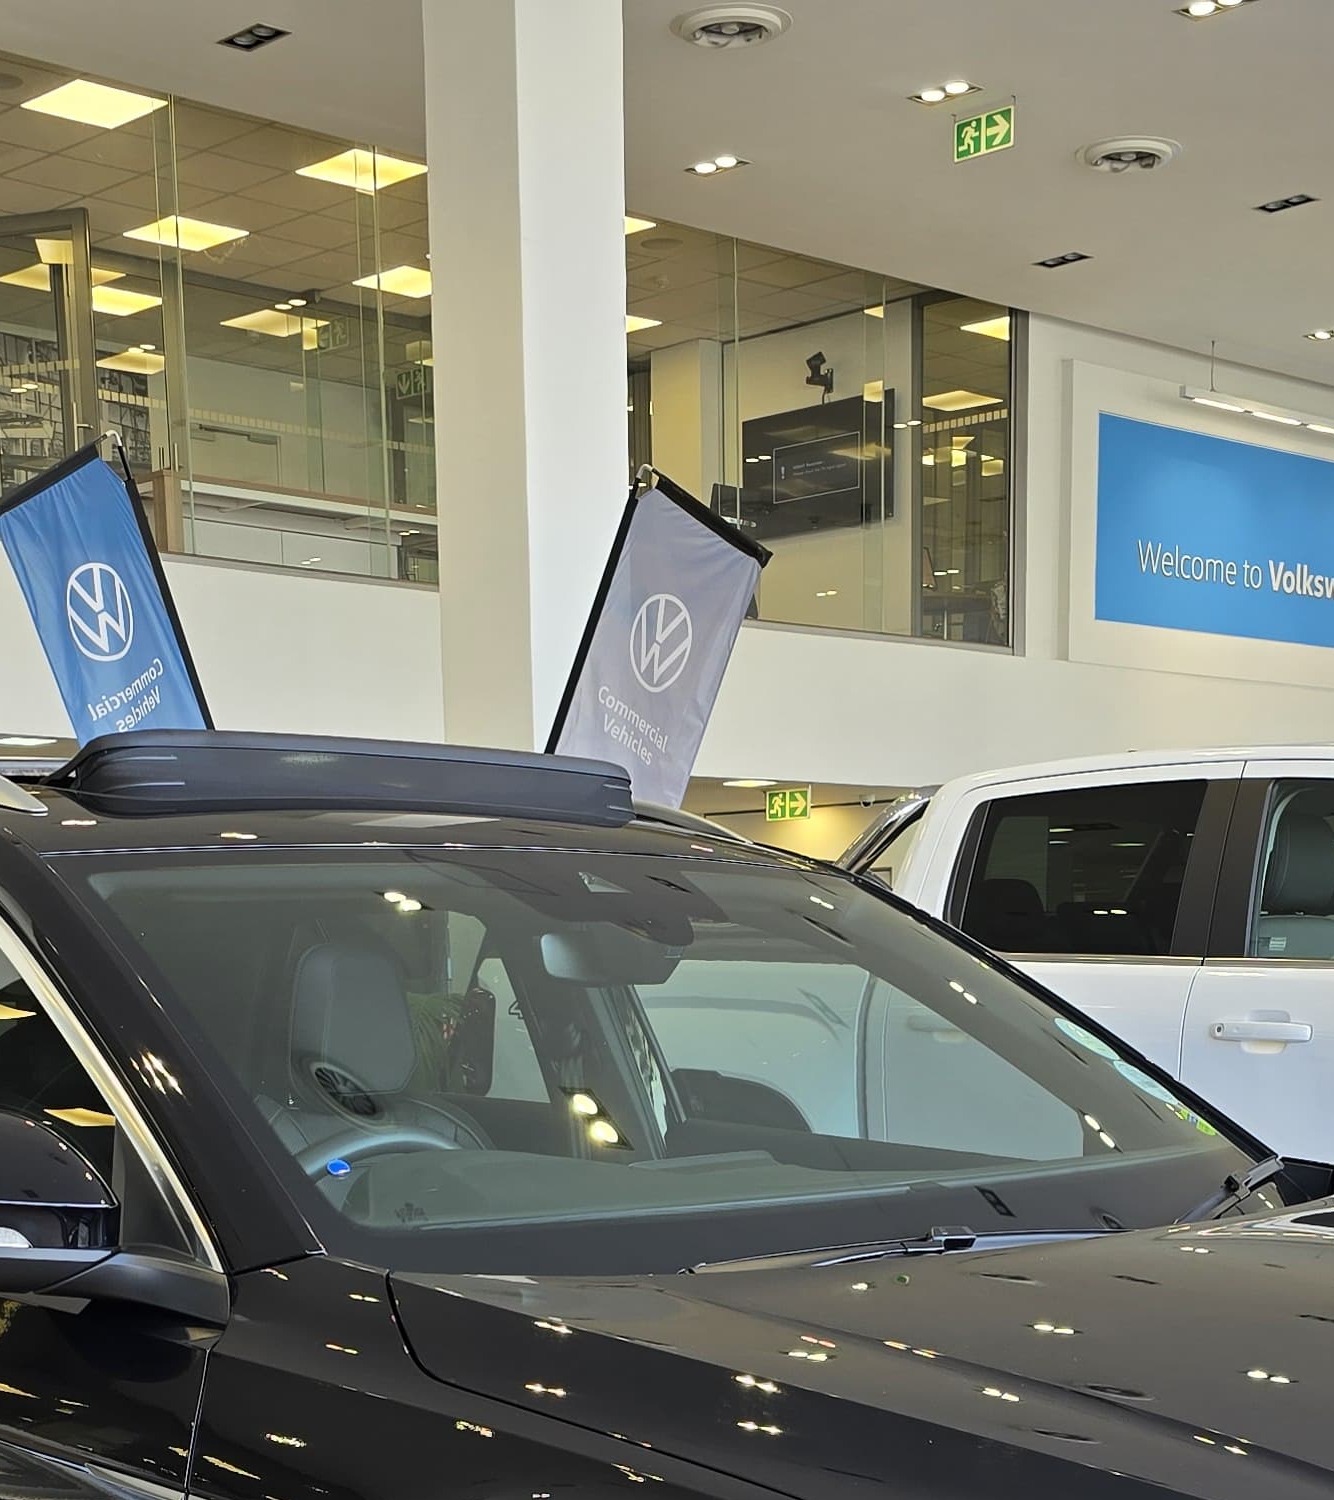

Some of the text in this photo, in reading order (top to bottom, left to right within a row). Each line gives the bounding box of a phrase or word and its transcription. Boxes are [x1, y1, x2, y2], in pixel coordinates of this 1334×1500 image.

[1137, 538, 1237, 586] Welcome
[1242, 559, 1262, 590] to
[597, 685, 669, 753] Commercial
[603, 713, 653, 767] Vehicles
